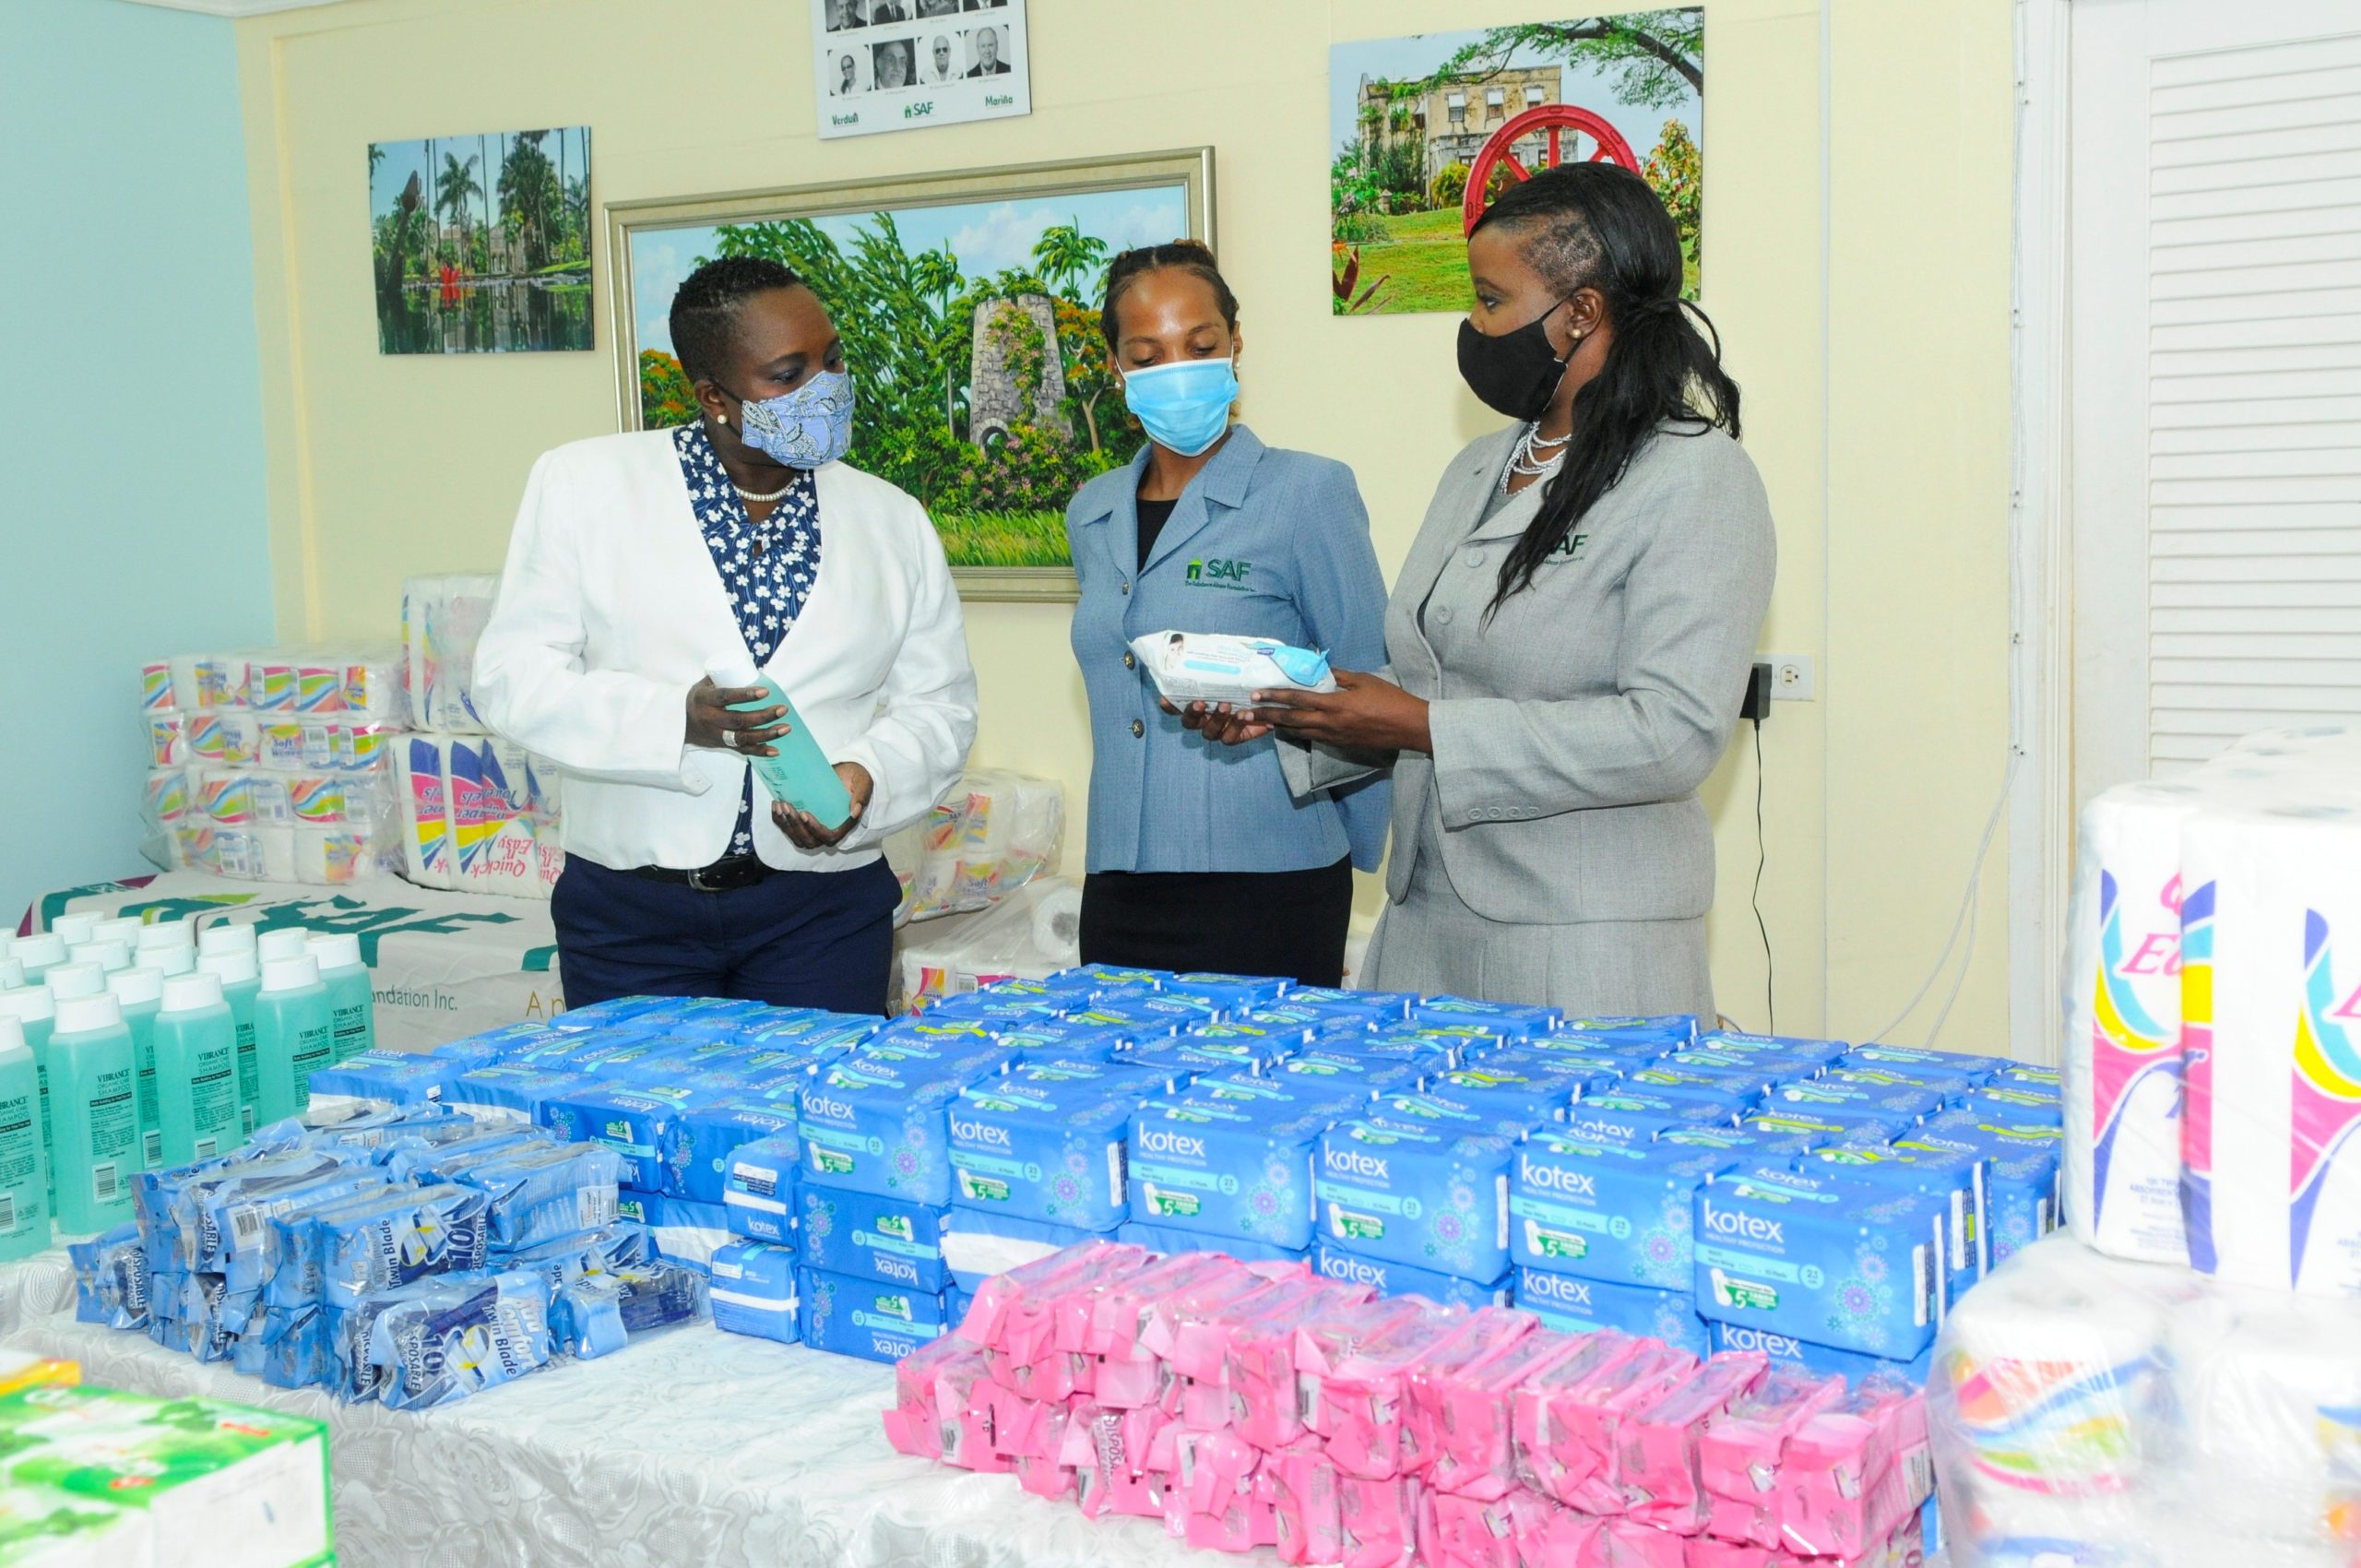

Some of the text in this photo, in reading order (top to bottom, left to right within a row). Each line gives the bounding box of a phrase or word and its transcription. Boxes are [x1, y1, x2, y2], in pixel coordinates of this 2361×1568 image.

[913, 101, 933, 116] SAF
[832, 112, 859, 126] Verdun
[1205, 558, 1252, 582] SAF
[540, 869, 561, 885] Qui
[372, 984, 457, 1011] ndation Inc.
[526, 991, 543, 1018] A
[333, 1004, 364, 1017] VIBRANCE
[235, 1023, 255, 1033] VIBRA
[333, 1017, 364, 1029] SHAMPOO
[299, 1026, 328, 1040] VIBRANCE
[797, 1028, 843, 1046] kotex
[300, 1039, 328, 1052] SHAMPOO
[886, 1036, 933, 1051] kotex
[197, 1047, 230, 1062] VIBRANCE
[97, 1068, 130, 1083] VIBRANCE
[199, 1062, 230, 1075] SHAMPOO
[851, 1058, 900, 1079] kotex
[97, 1084, 130, 1097] SHAMPOO
[0, 1095, 29, 1110] BRANCE
[0, 1107, 17, 1116] GANIC
[802, 1088, 855, 1121] kotex
[1, 1111, 30, 1123] AMPOO
[733, 1113, 787, 1132] kotex
[1768, 1107, 1824, 1124] kotex
[950, 1111, 1011, 1146] kotex
[1138, 1121, 1205, 1158] kotex
[1920, 1134, 1979, 1153] kotex
[825, 1159, 834, 1173] 5
[1324, 1138, 1389, 1179] kotex
[1521, 1152, 1596, 1197] kotex
[1756, 1166, 1822, 1190] kotex
[978, 1184, 986, 1201] 5
[1164, 1200, 1173, 1218] 5
[747, 1216, 780, 1236] kotex
[1704, 1198, 1785, 1244] kotex
[1347, 1222, 1358, 1240] 5
[379, 1218, 402, 1291] Twin Blade
[446, 1228, 476, 1263] 10
[1546, 1240, 1558, 1258] 5
[874, 1257, 919, 1286] kotex
[1321, 1247, 1387, 1289] kotex
[1524, 1267, 1591, 1305] kotex
[1734, 1289, 1747, 1309] 5
[481, 1303, 518, 1376] Twin Blade
[1721, 1322, 1803, 1360] kotex
[421, 1334, 445, 1372] 10
[409, 1334, 421, 1392] SPOSABLE
